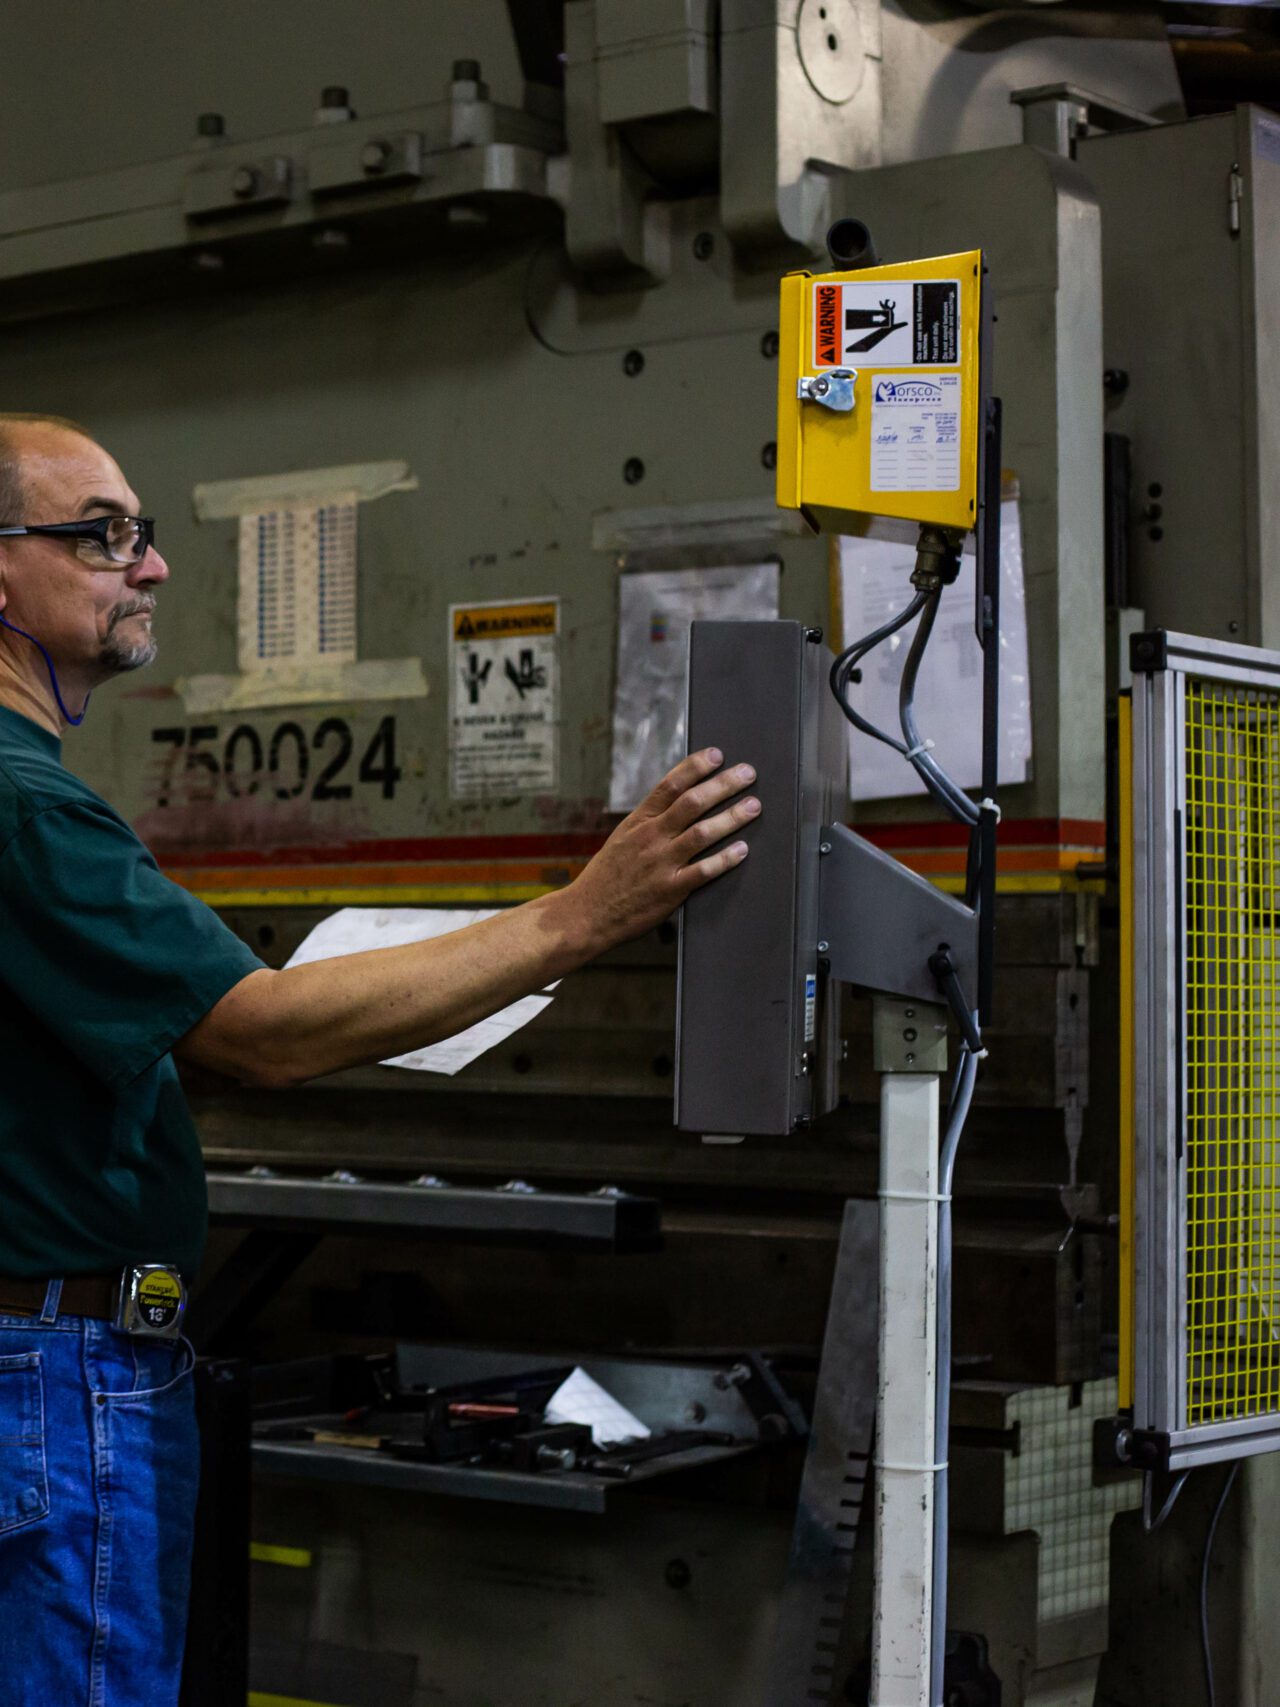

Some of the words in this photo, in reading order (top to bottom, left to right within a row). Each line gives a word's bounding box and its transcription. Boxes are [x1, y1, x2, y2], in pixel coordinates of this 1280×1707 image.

[820, 286, 836, 347] WARNING
[475, 614, 554, 633] WARNING
[151, 715, 401, 808] 750024
